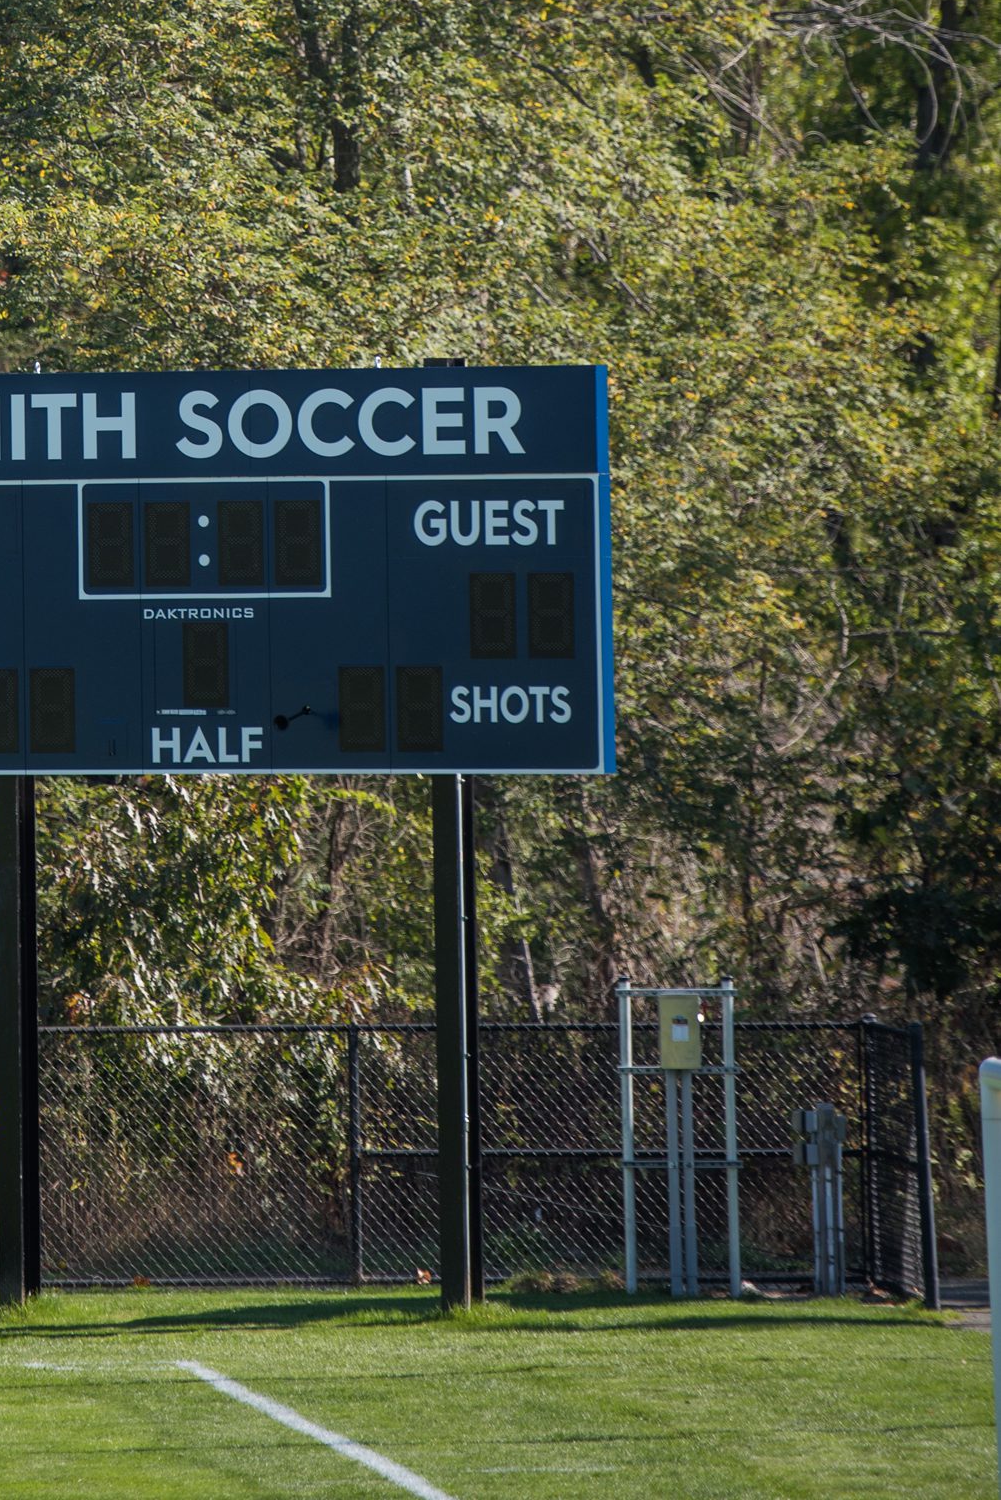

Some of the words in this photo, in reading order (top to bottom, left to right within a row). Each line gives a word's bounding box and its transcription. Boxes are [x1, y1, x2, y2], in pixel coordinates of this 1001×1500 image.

[175, 386, 527, 460] SOCCER
[413, 498, 566, 547] GUEST
[143, 607, 255, 620] DAKTRONICS
[449, 684, 572, 724] SHOTS
[151, 725, 264, 763] HALF
